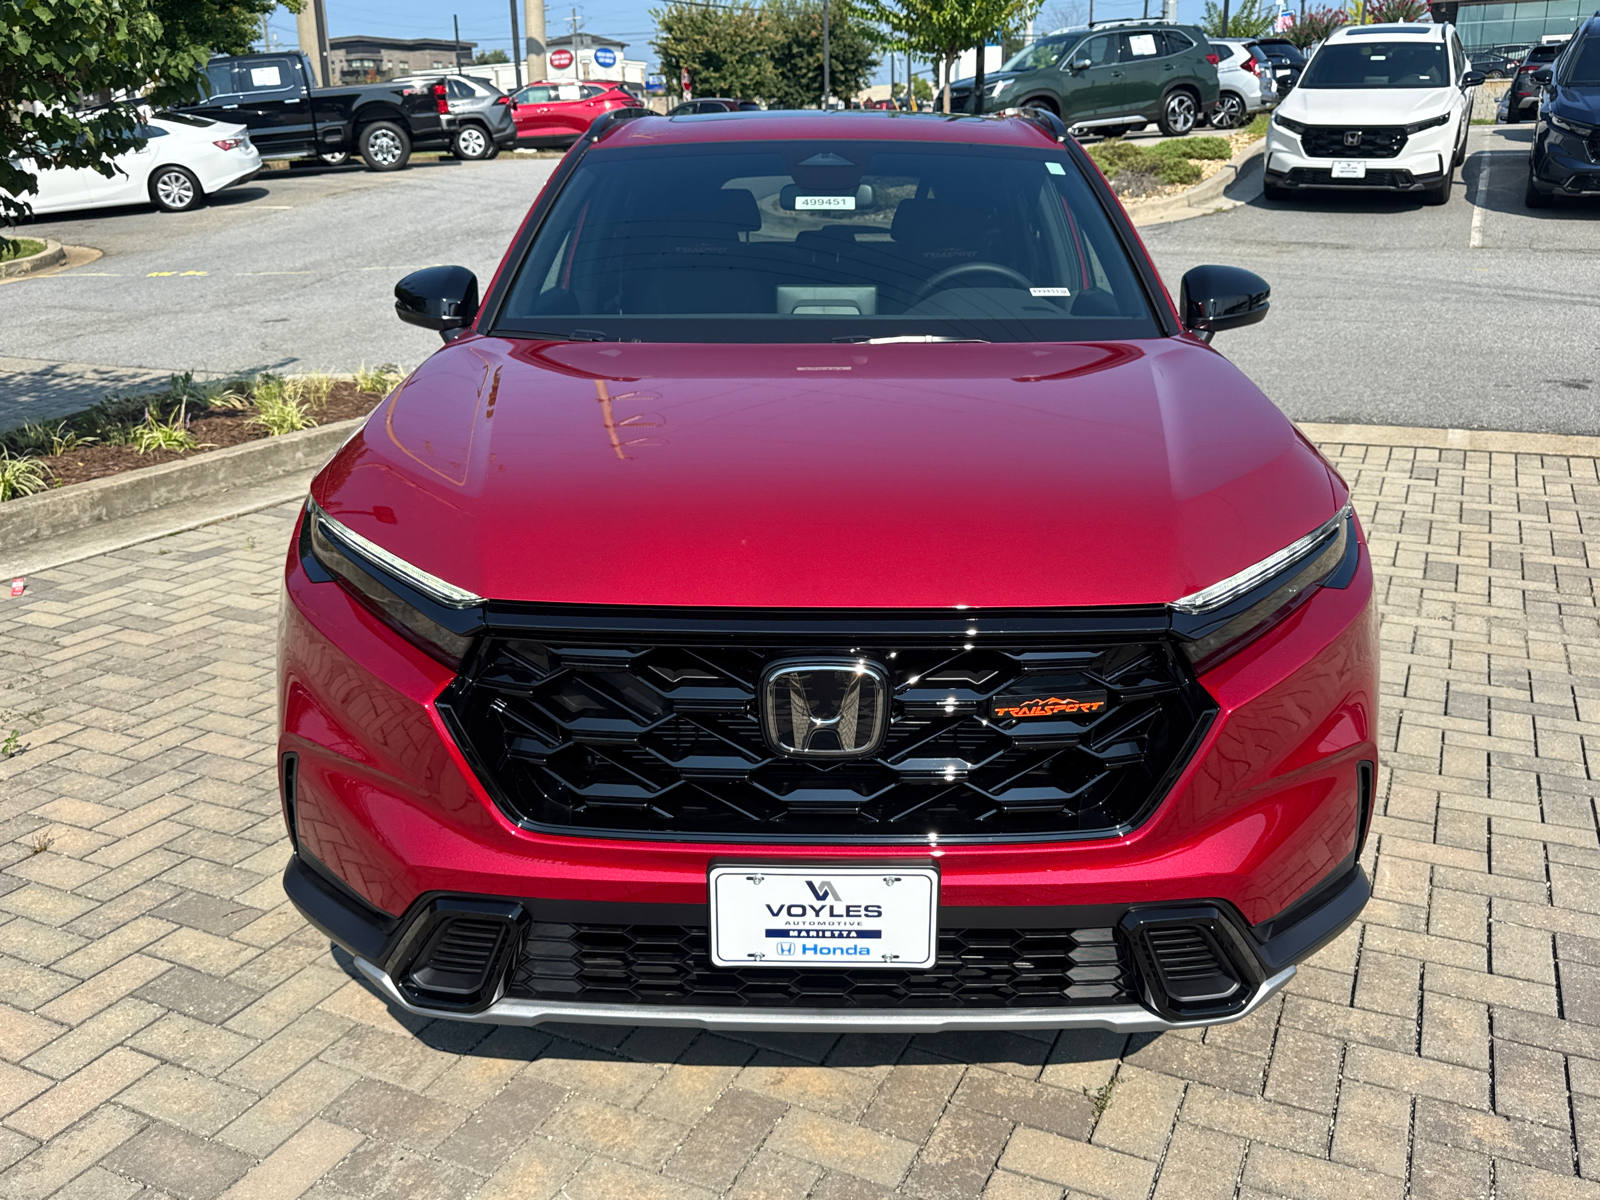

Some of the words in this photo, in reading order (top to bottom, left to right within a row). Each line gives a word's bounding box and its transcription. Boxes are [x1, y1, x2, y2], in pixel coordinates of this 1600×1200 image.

[802, 198, 846, 206] 499451
[994, 701, 1105, 718] TRAILSPORT
[765, 904, 883, 918] VOYLES
[789, 930, 858, 938] MARIETTA
[802, 943, 871, 956] Honda
